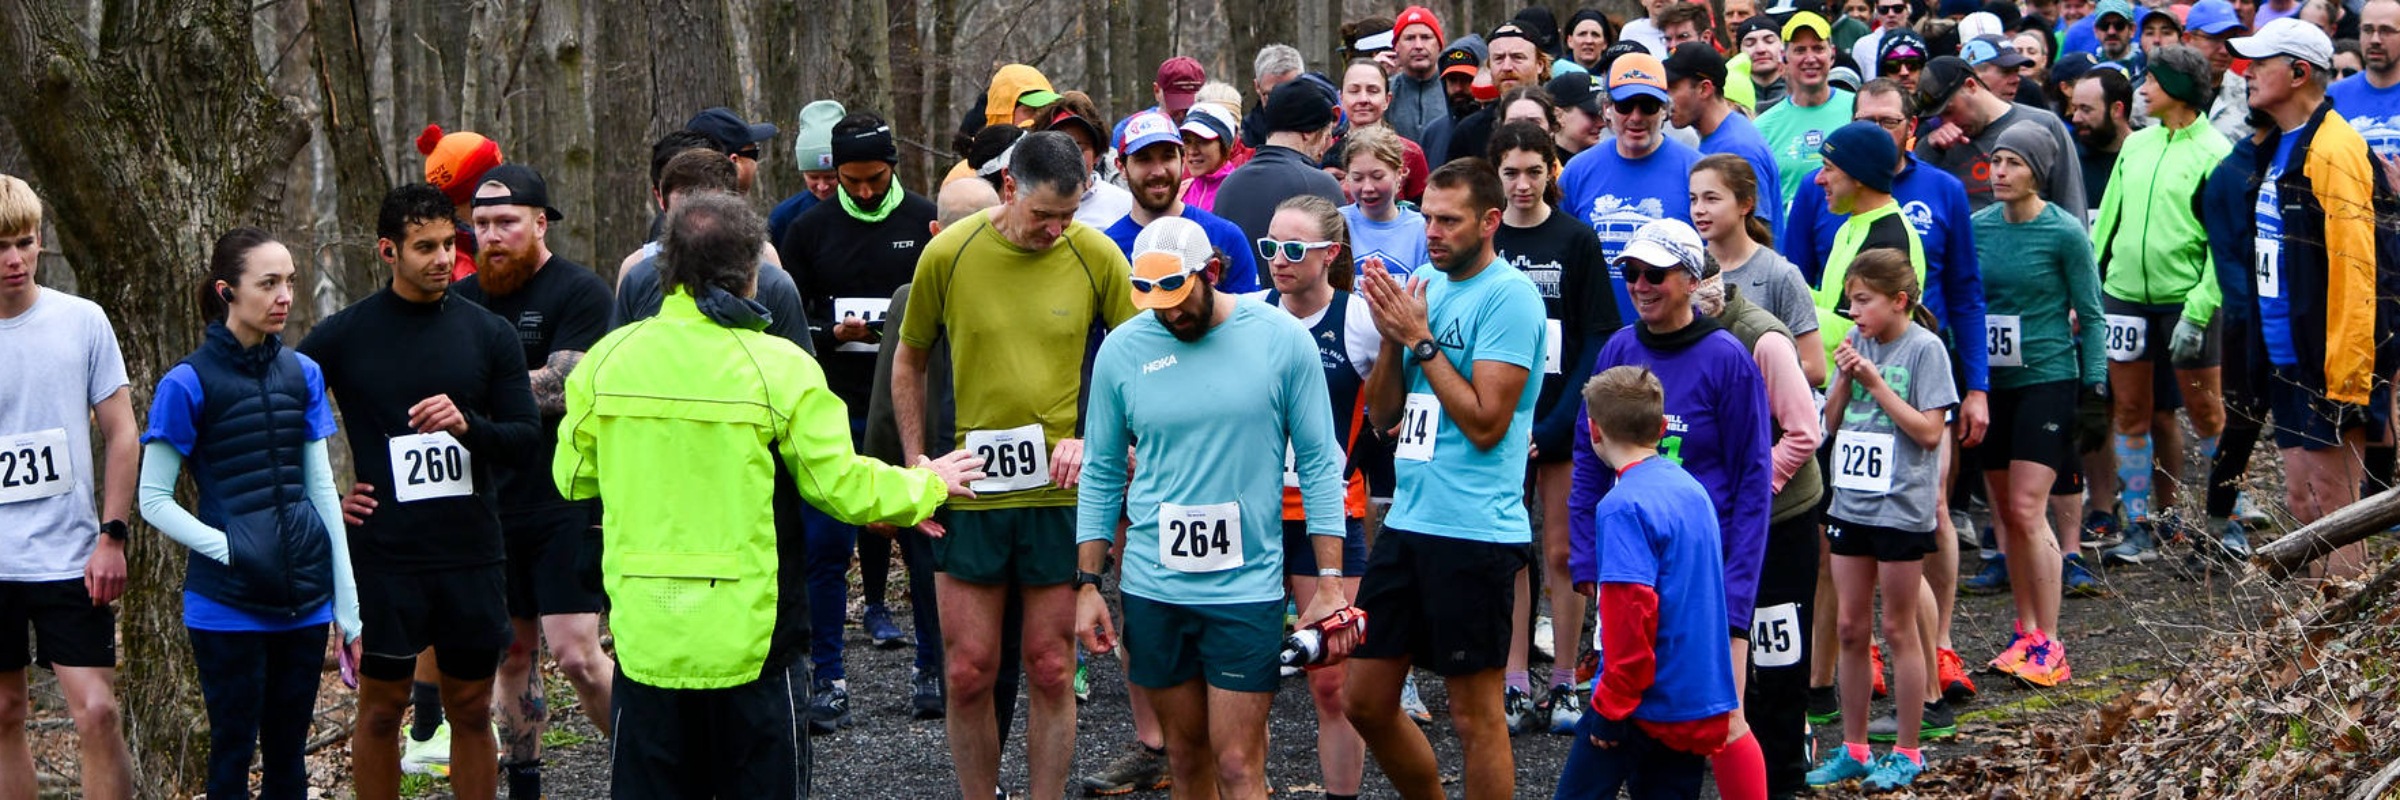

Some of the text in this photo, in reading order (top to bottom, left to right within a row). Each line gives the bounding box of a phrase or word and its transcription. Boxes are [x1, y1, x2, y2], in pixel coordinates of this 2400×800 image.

[1988, 326, 2012, 356] 35
[1143, 354, 1178, 375] HOKA
[0, 445, 60, 488] 231
[405, 445, 462, 485] 260
[978, 440, 1036, 478] 269
[1842, 443, 1883, 478] 226
[1169, 519, 1231, 558] 264
